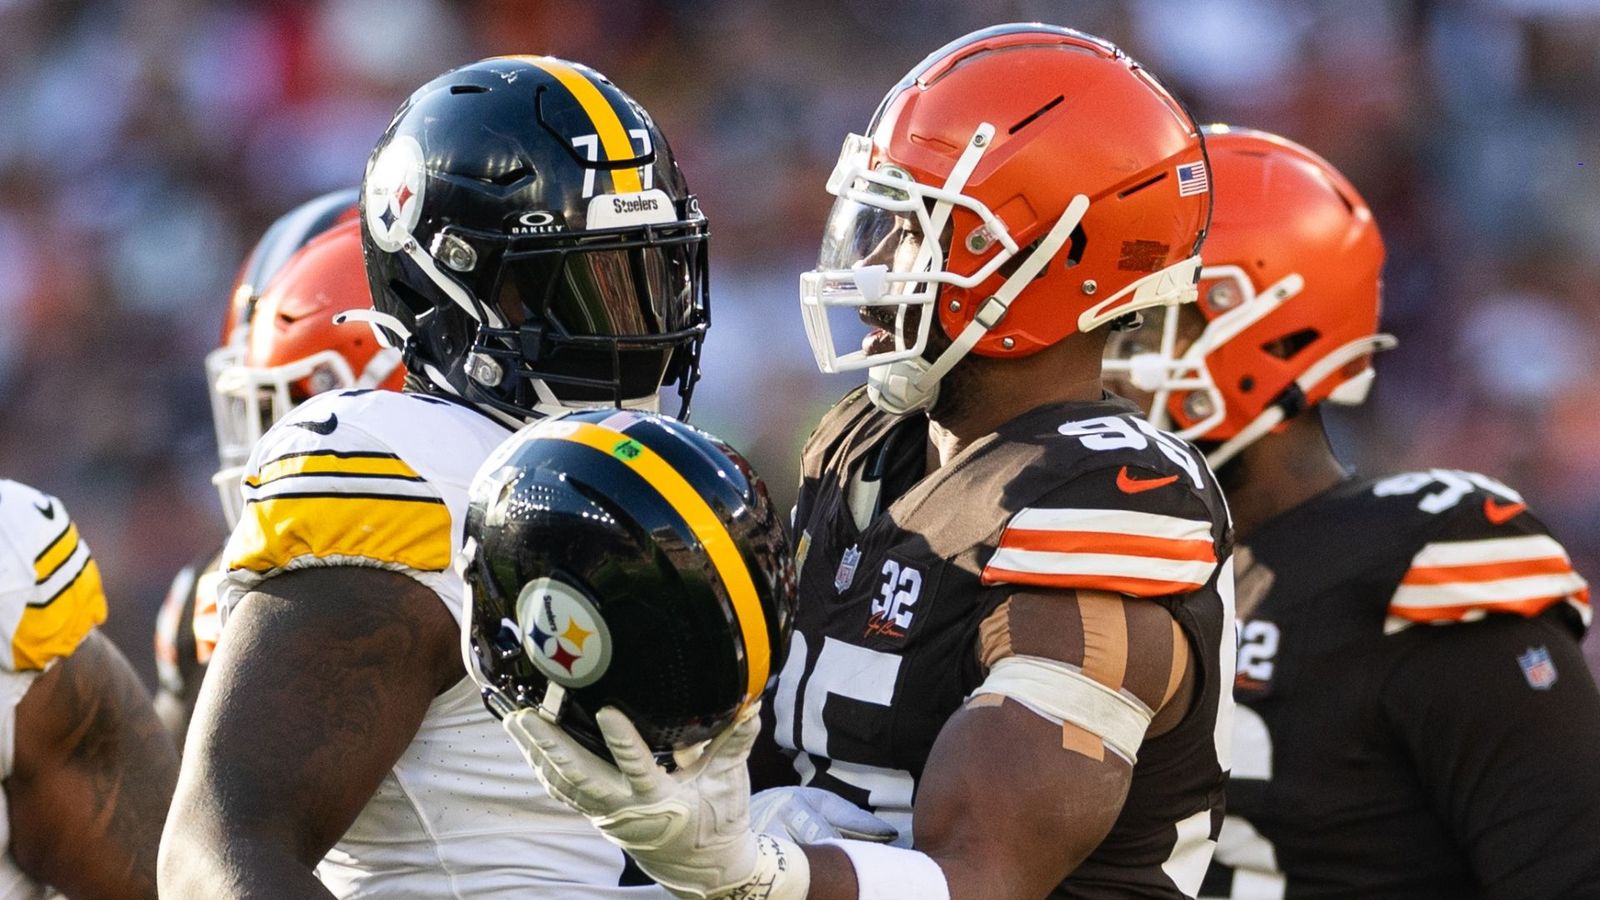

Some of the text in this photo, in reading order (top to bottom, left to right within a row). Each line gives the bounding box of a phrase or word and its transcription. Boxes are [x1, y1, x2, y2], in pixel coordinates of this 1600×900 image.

[612, 195, 659, 214] Steelers
[511, 224, 564, 234] OAKLEY
[871, 559, 922, 629] 32
[1236, 618, 1281, 681] 2
